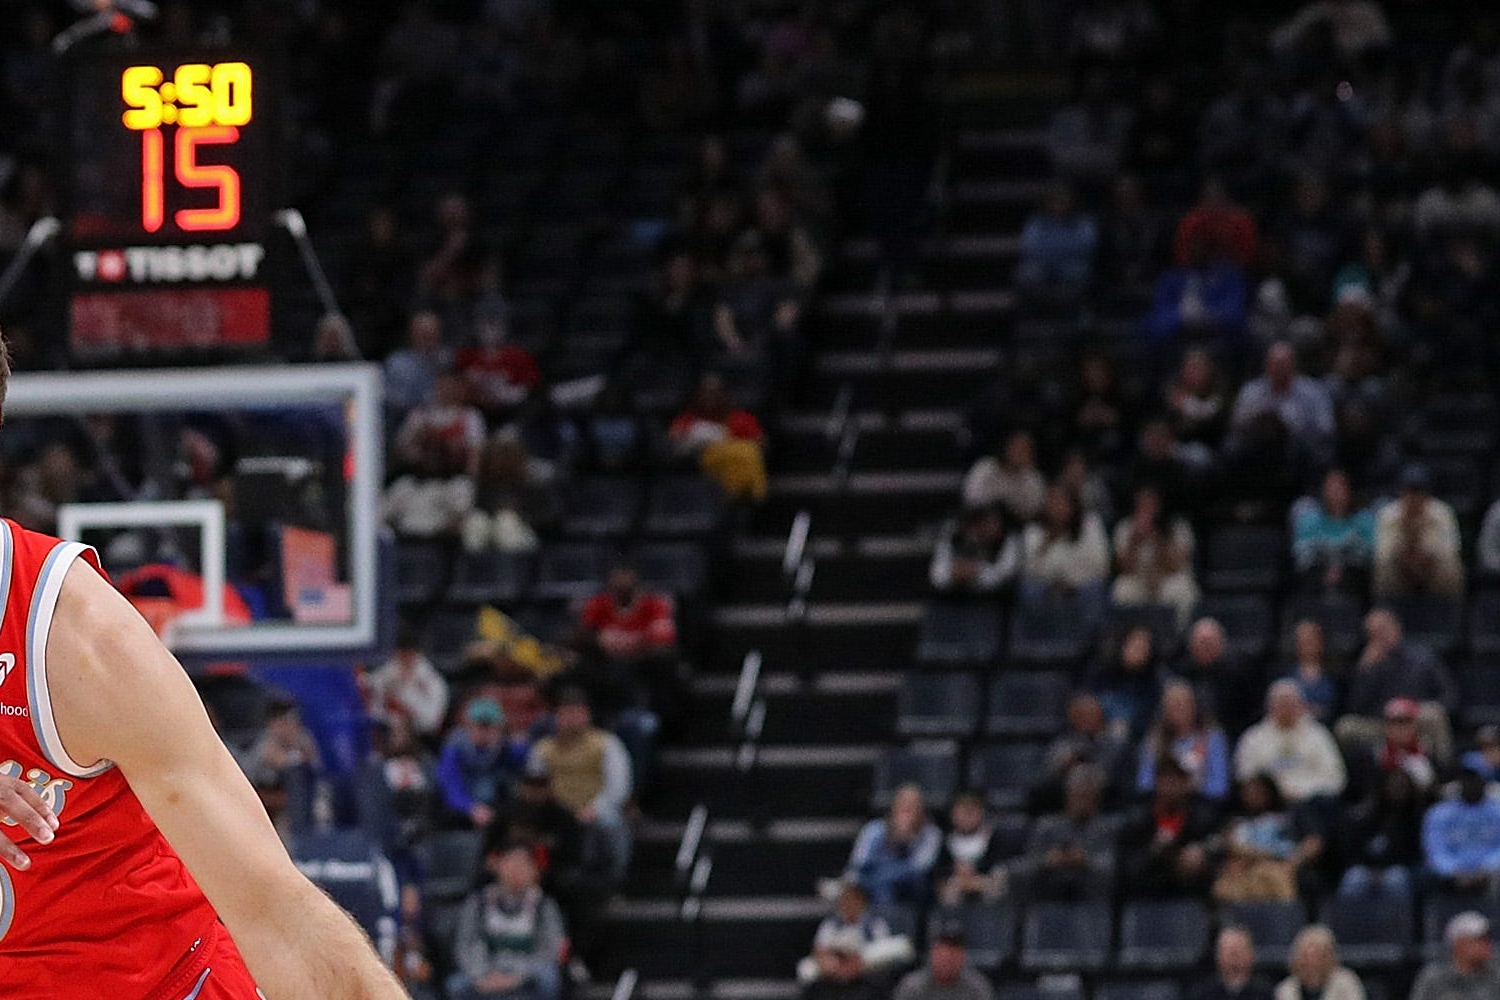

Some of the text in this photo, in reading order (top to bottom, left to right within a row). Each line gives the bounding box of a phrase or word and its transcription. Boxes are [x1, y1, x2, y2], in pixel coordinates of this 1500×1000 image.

[122, 62, 252, 130] 5:50
[142, 127, 240, 232] 15
[128, 244, 264, 281] TISSOT
